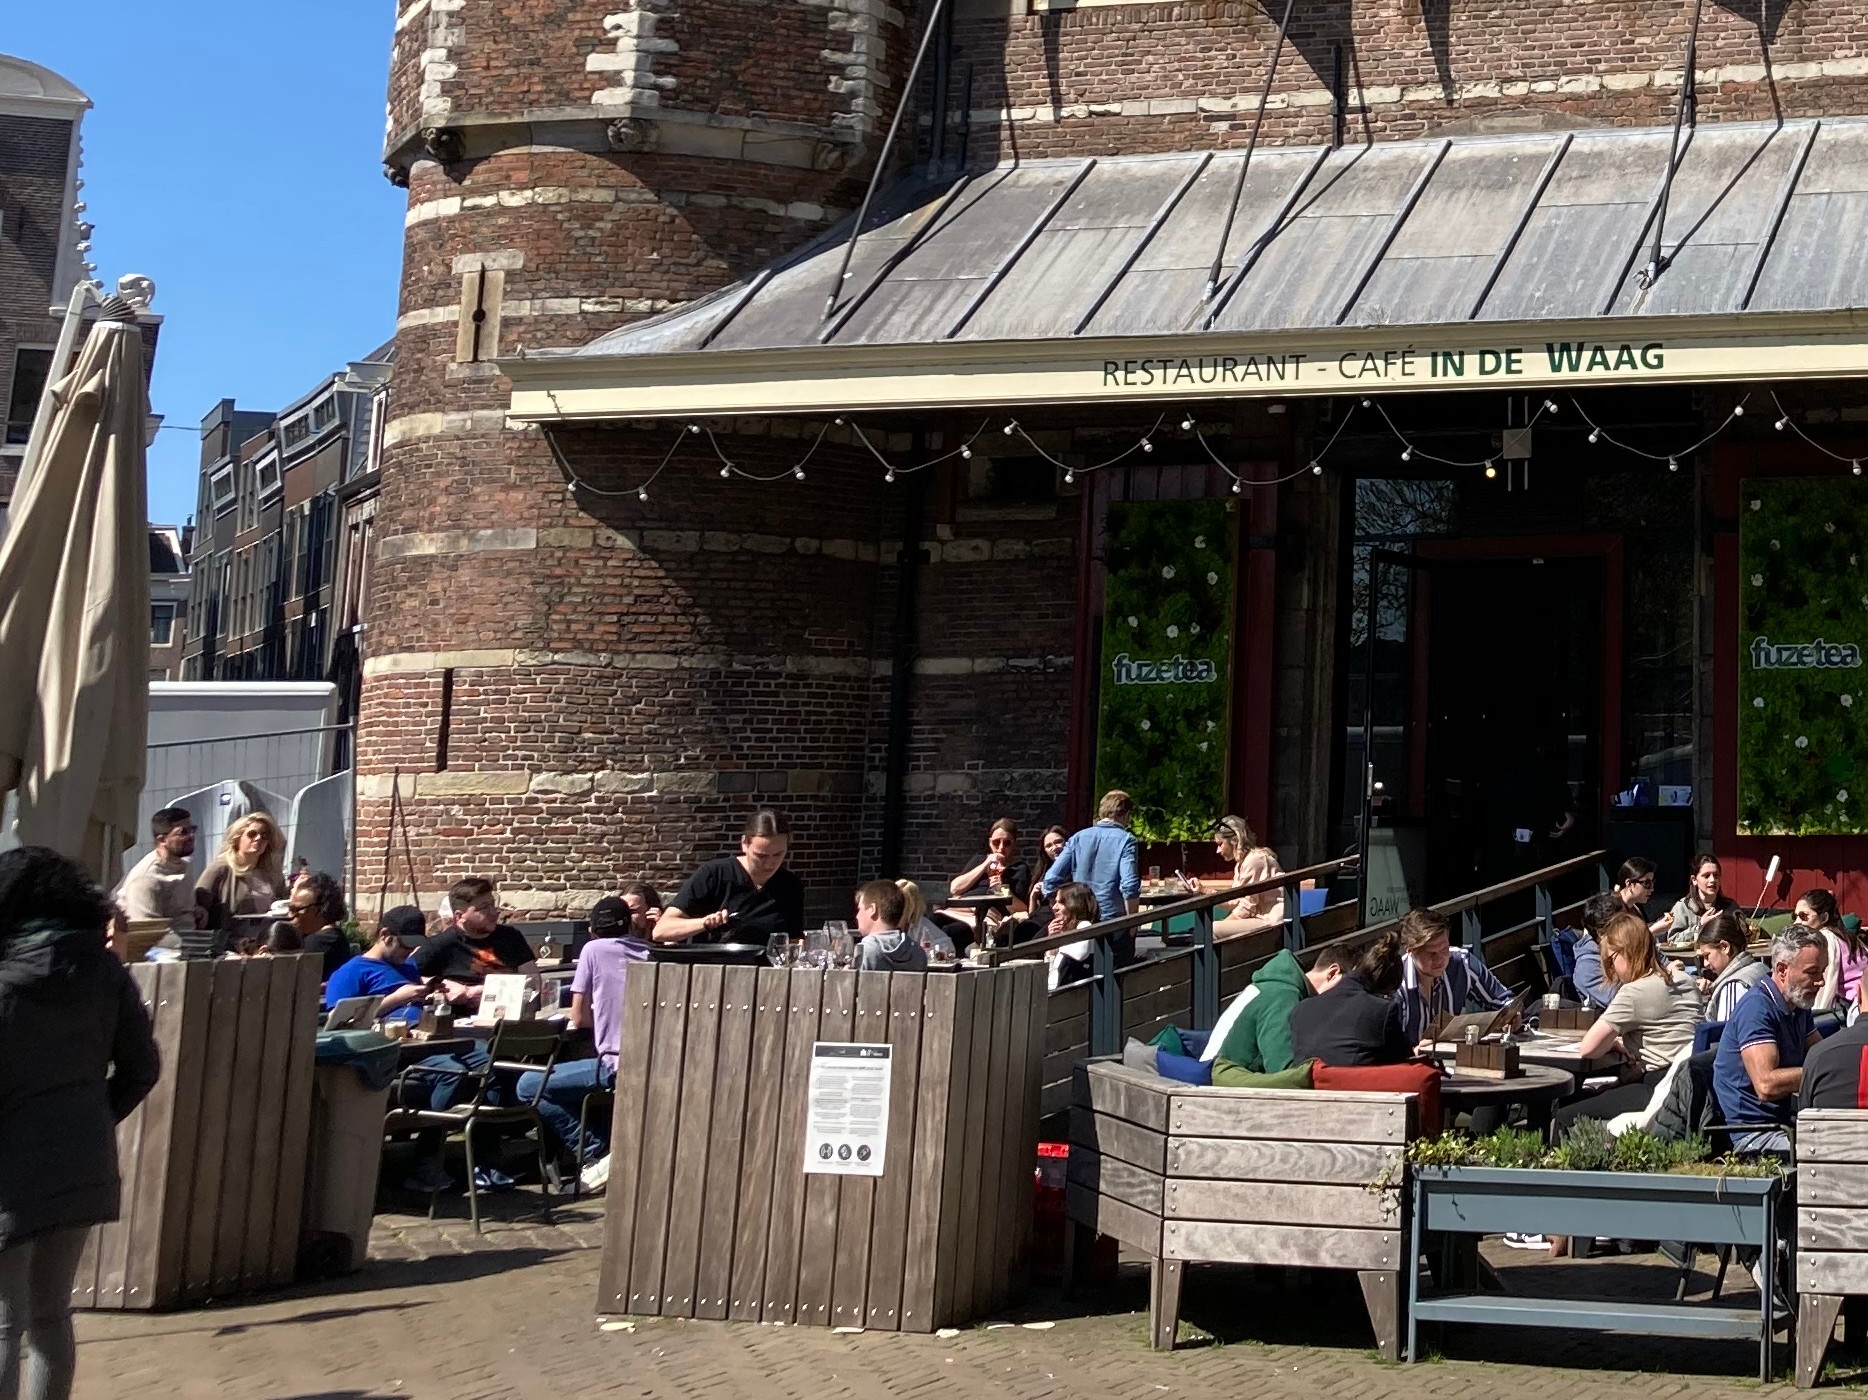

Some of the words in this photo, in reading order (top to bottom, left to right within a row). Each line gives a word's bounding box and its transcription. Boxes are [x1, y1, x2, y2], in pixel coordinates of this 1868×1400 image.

[1103, 353, 1307, 387] RESTAURANT
[1338, 344, 1416, 379] CAFÉ
[1430, 350, 1465, 378] IN
[1478, 347, 1523, 376] DE
[1545, 341, 1665, 373] WAAG
[1114, 653, 1214, 683] fuzetea
[1752, 637, 1859, 668] fuzetea
